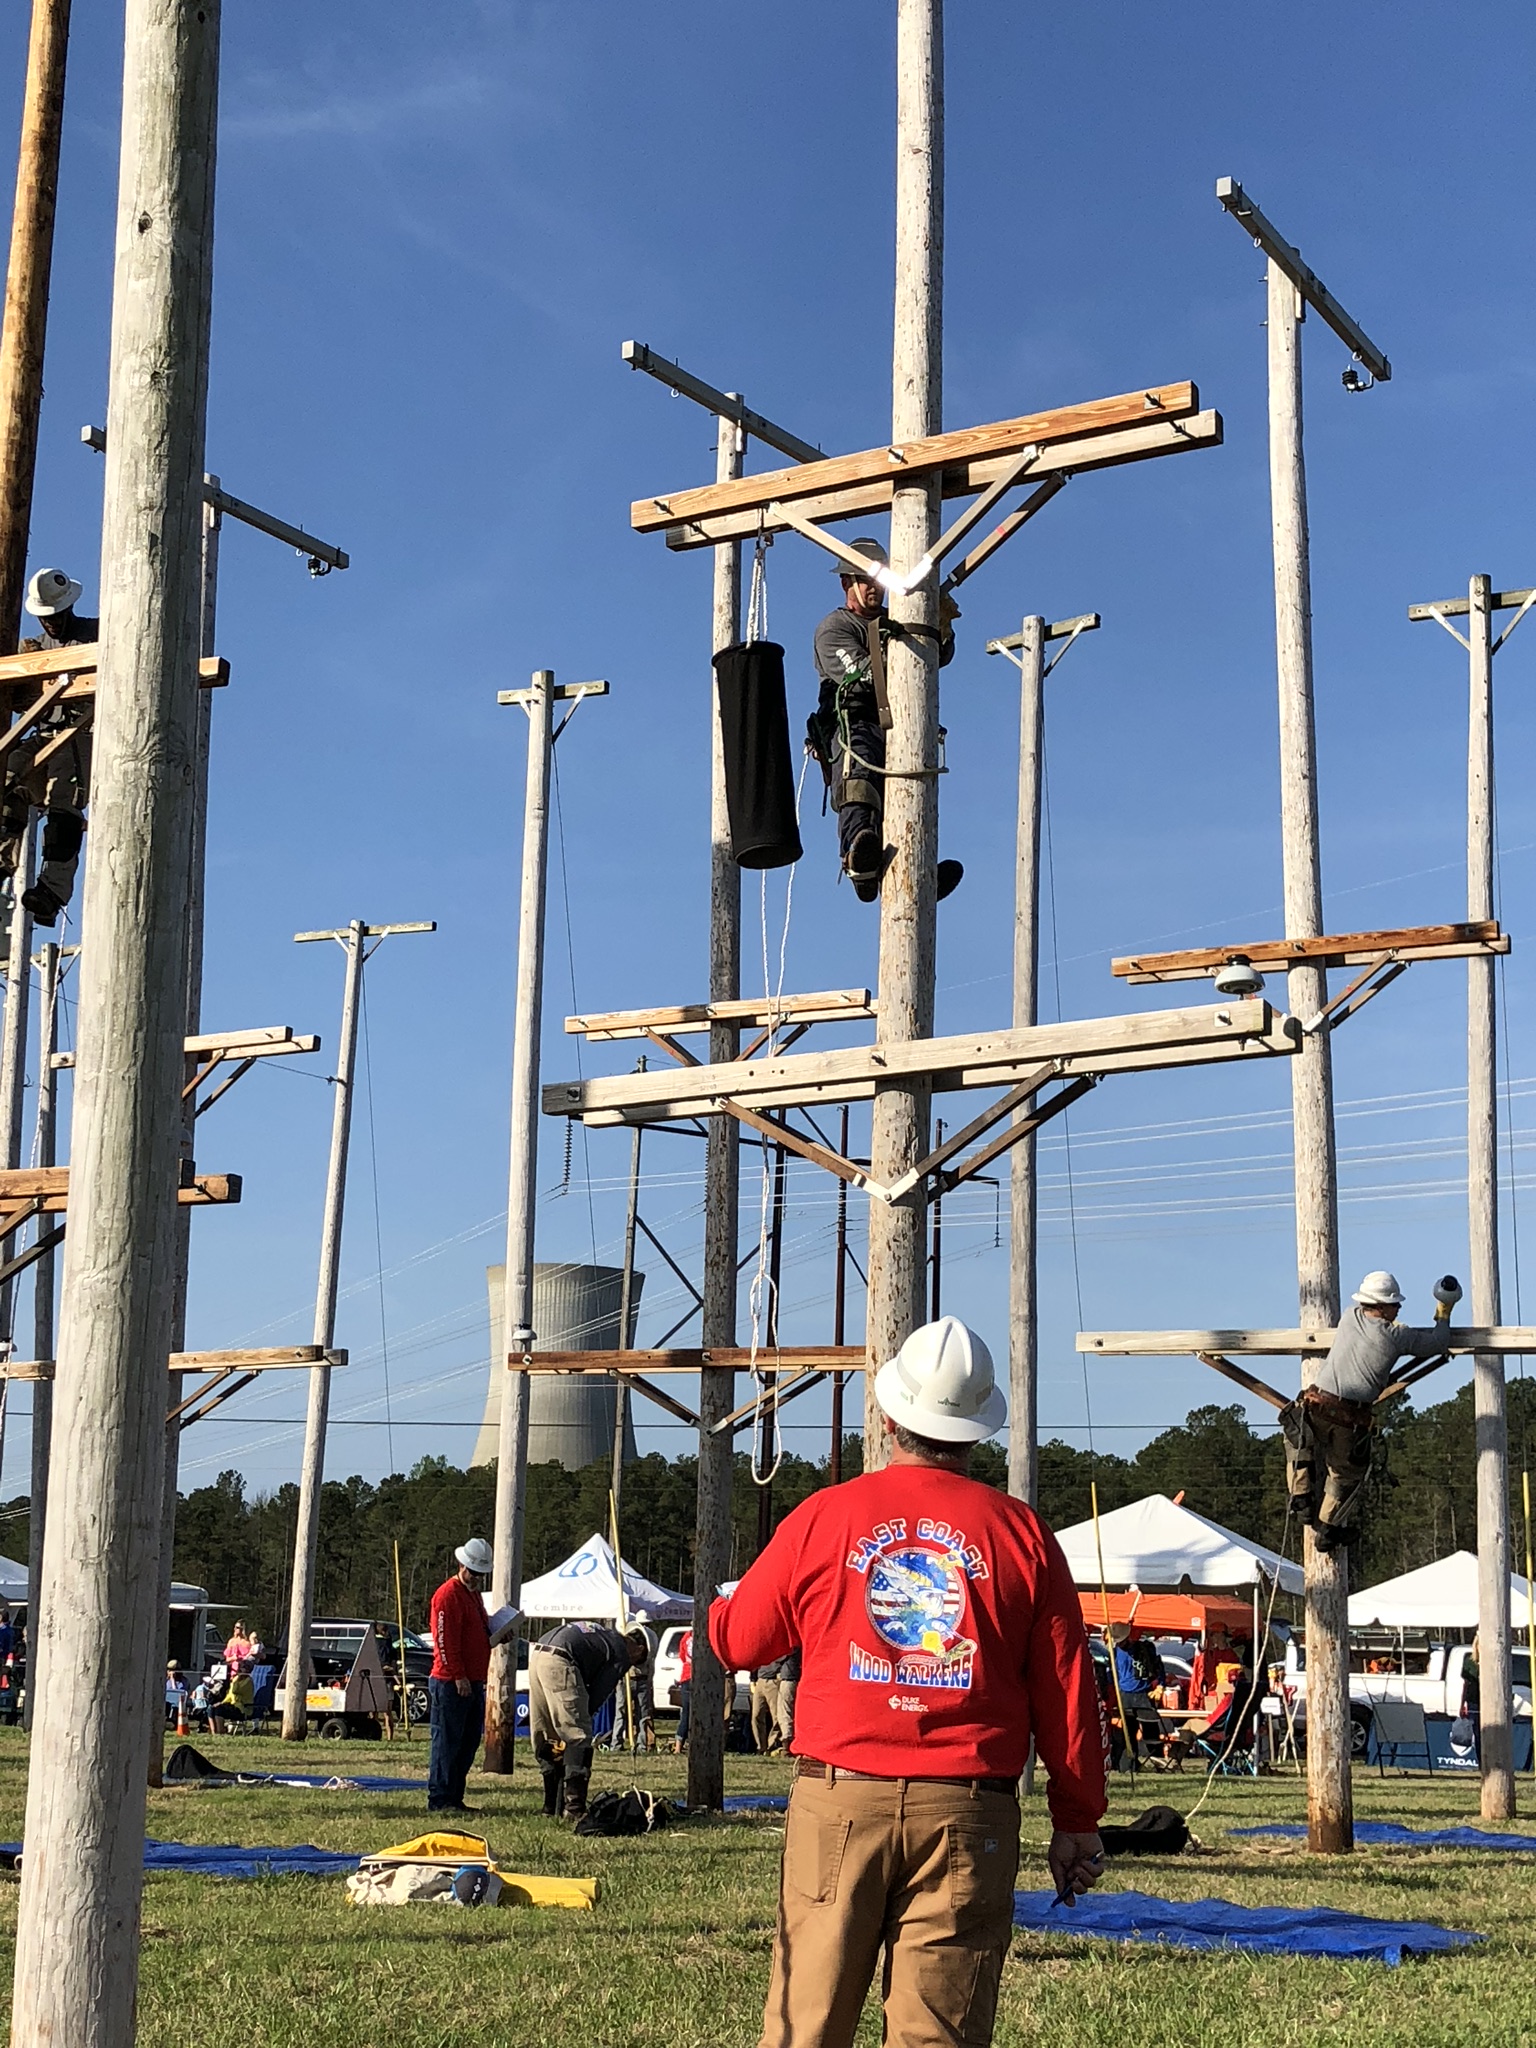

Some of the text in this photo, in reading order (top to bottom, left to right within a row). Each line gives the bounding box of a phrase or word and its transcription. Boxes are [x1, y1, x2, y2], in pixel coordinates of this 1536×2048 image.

[846, 1518, 990, 1581] EAST COAST
[534, 1603, 584, 1612] Cembre
[850, 1641, 974, 1690] WOOD WALKERS
[902, 1696, 920, 1705] DUKE
[902, 1704, 929, 1713] ENERGY
[1436, 1756, 1479, 1767] TYNDAL
